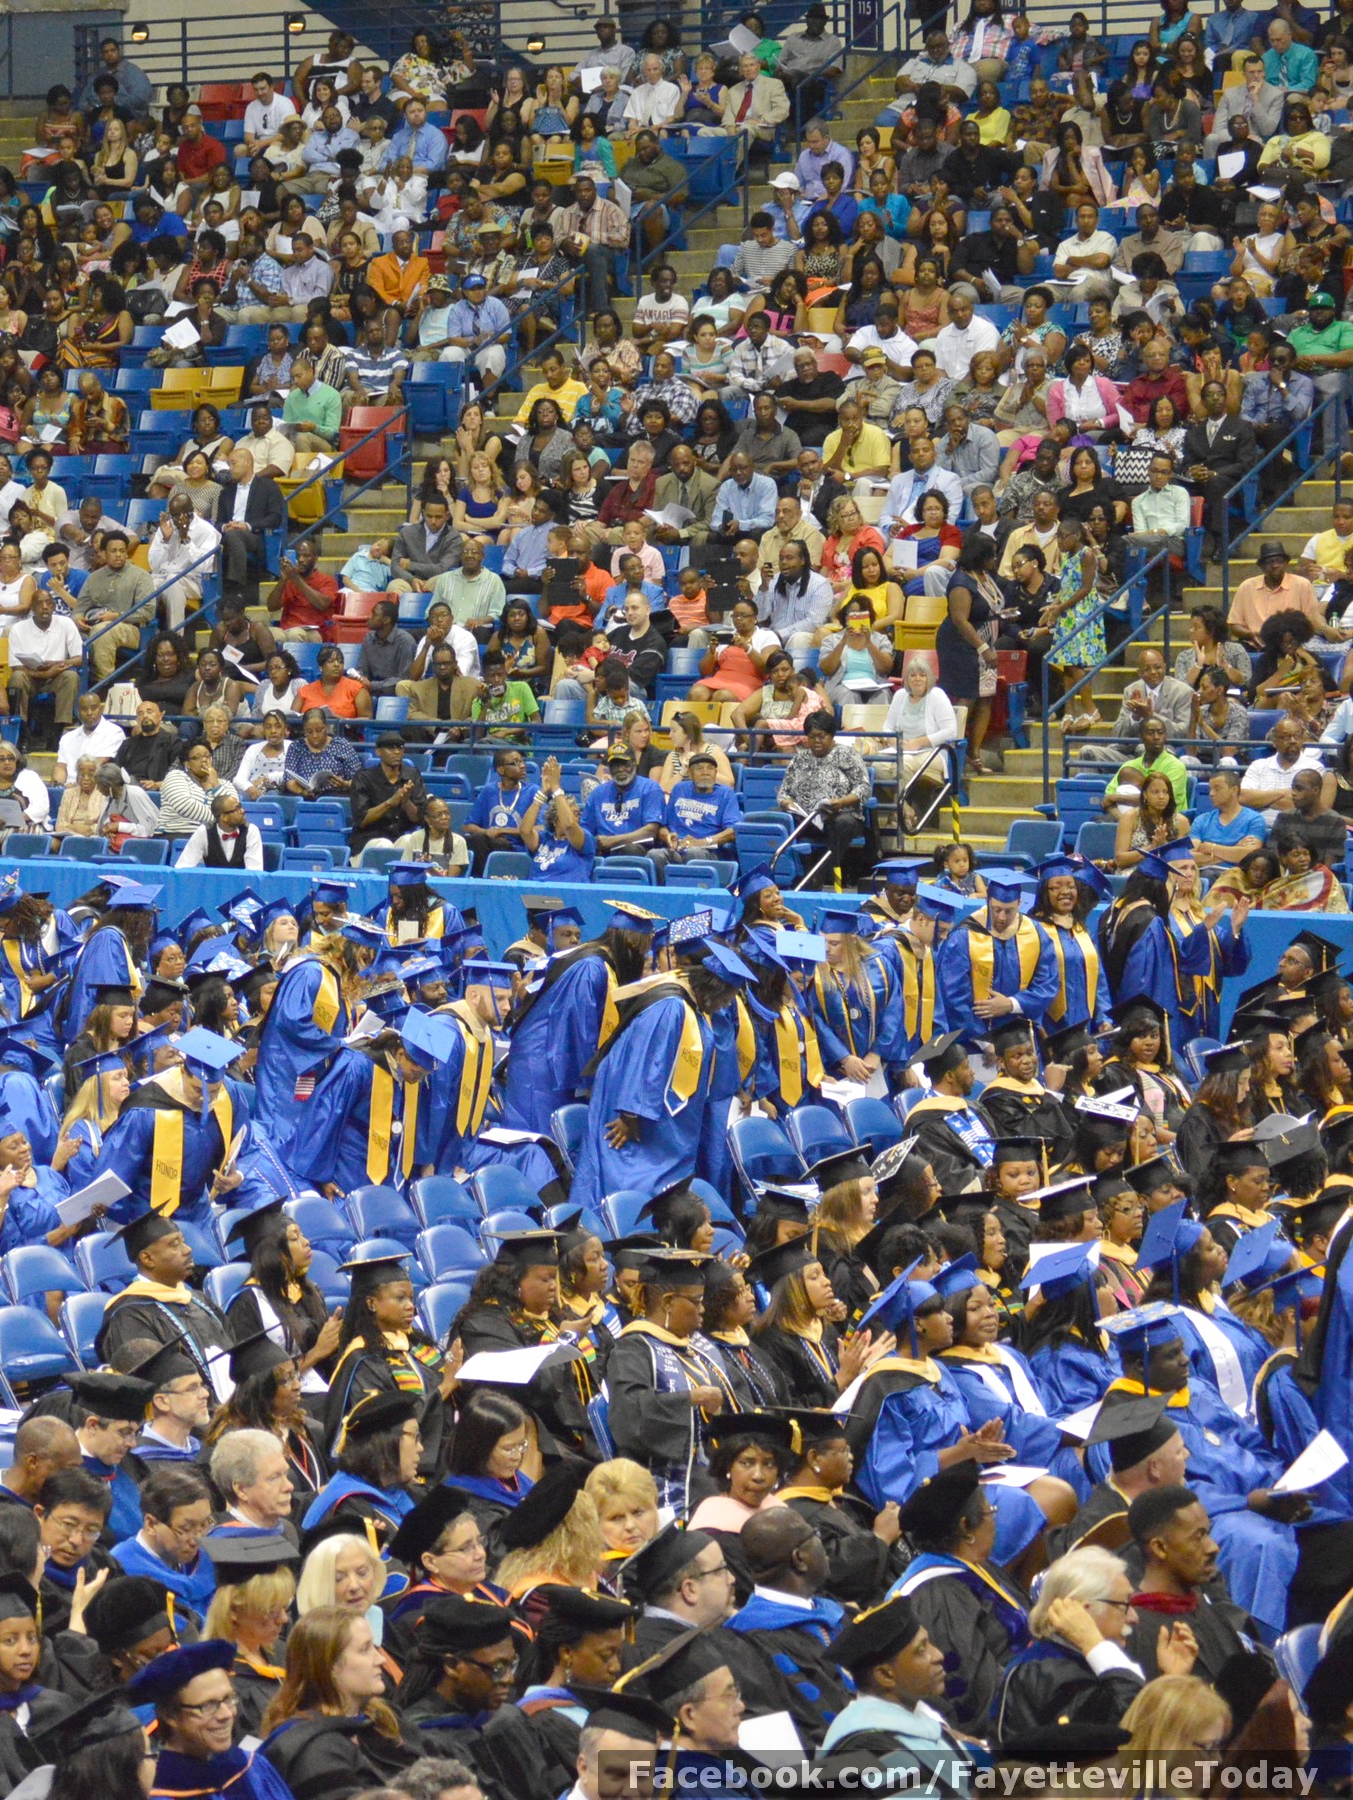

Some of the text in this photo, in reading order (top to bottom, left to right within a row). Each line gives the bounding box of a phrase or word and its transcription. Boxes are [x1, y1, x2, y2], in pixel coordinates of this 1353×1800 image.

[857, 1, 872, 15] 115
[681, 1047, 700, 1068] HONOR
[156, 1160, 178, 1180] HONOR
